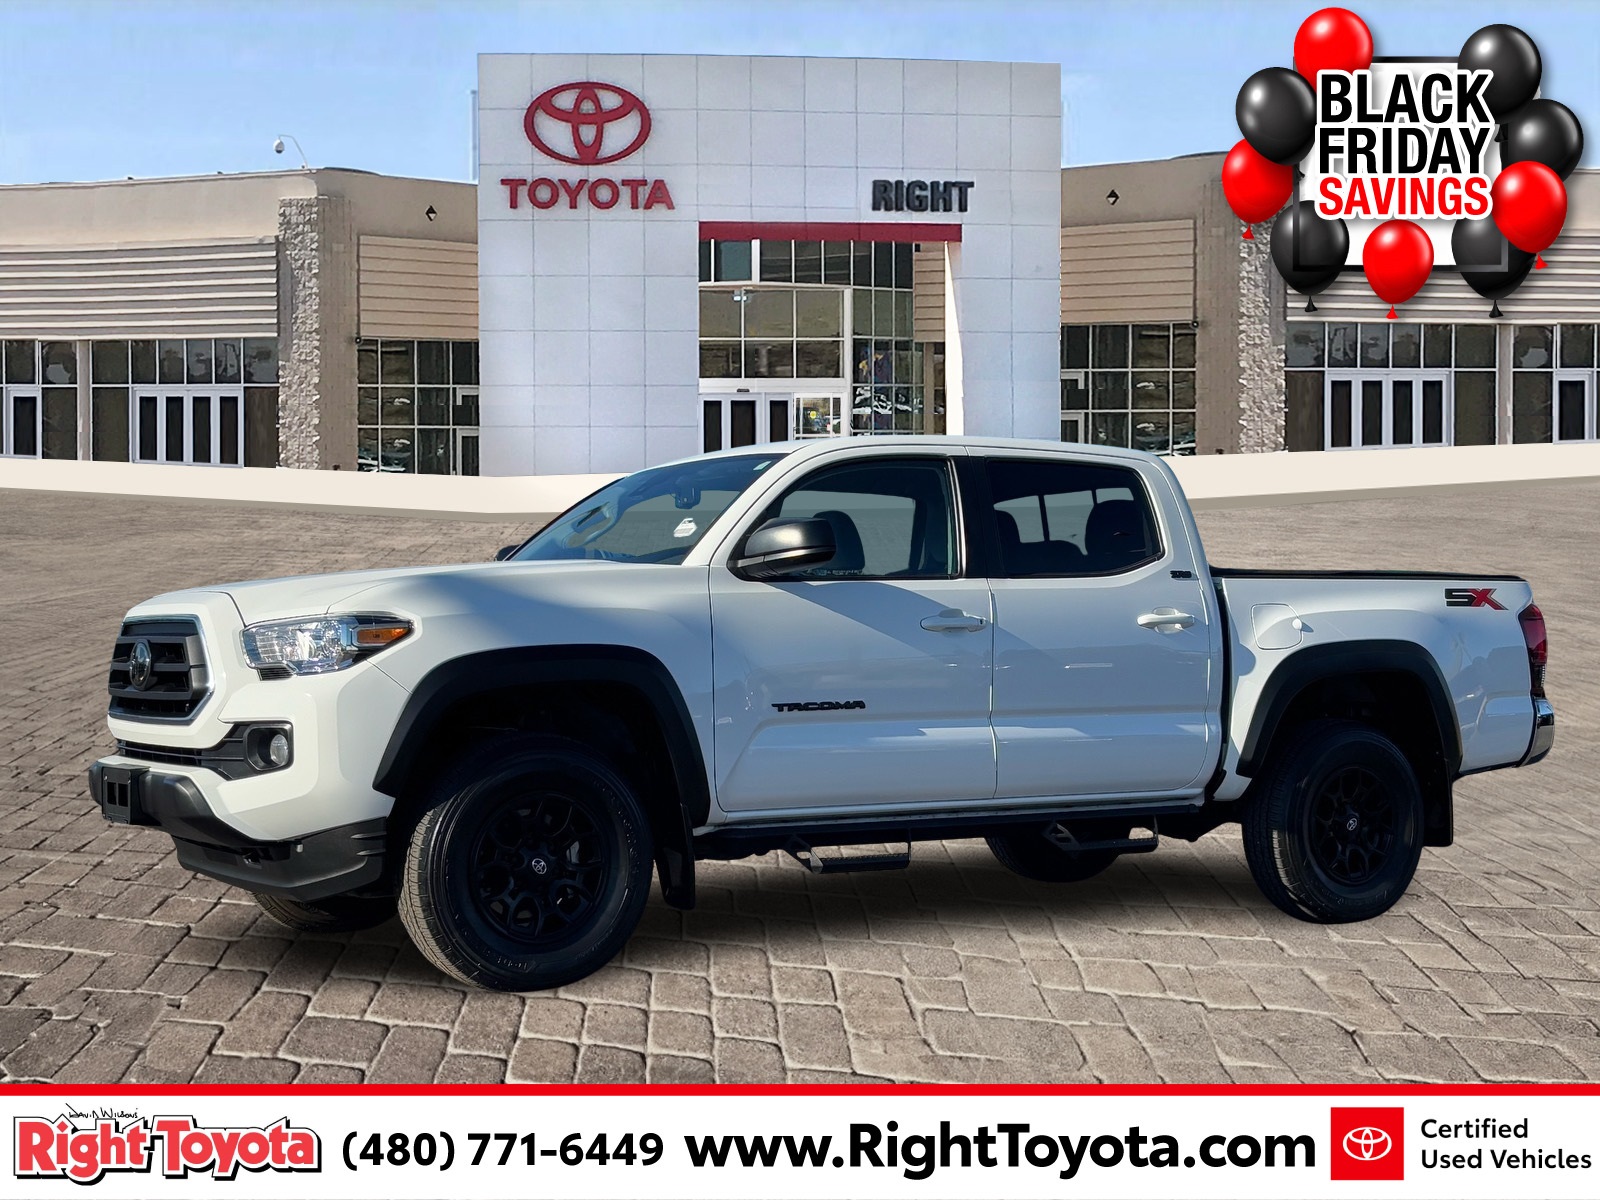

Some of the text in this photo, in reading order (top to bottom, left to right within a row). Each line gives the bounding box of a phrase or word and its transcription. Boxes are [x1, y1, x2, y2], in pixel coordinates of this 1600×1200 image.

[500, 178, 676, 210] TOYOTA
[872, 179, 975, 213] RIGHT
[771, 700, 866, 713] TACOMA
